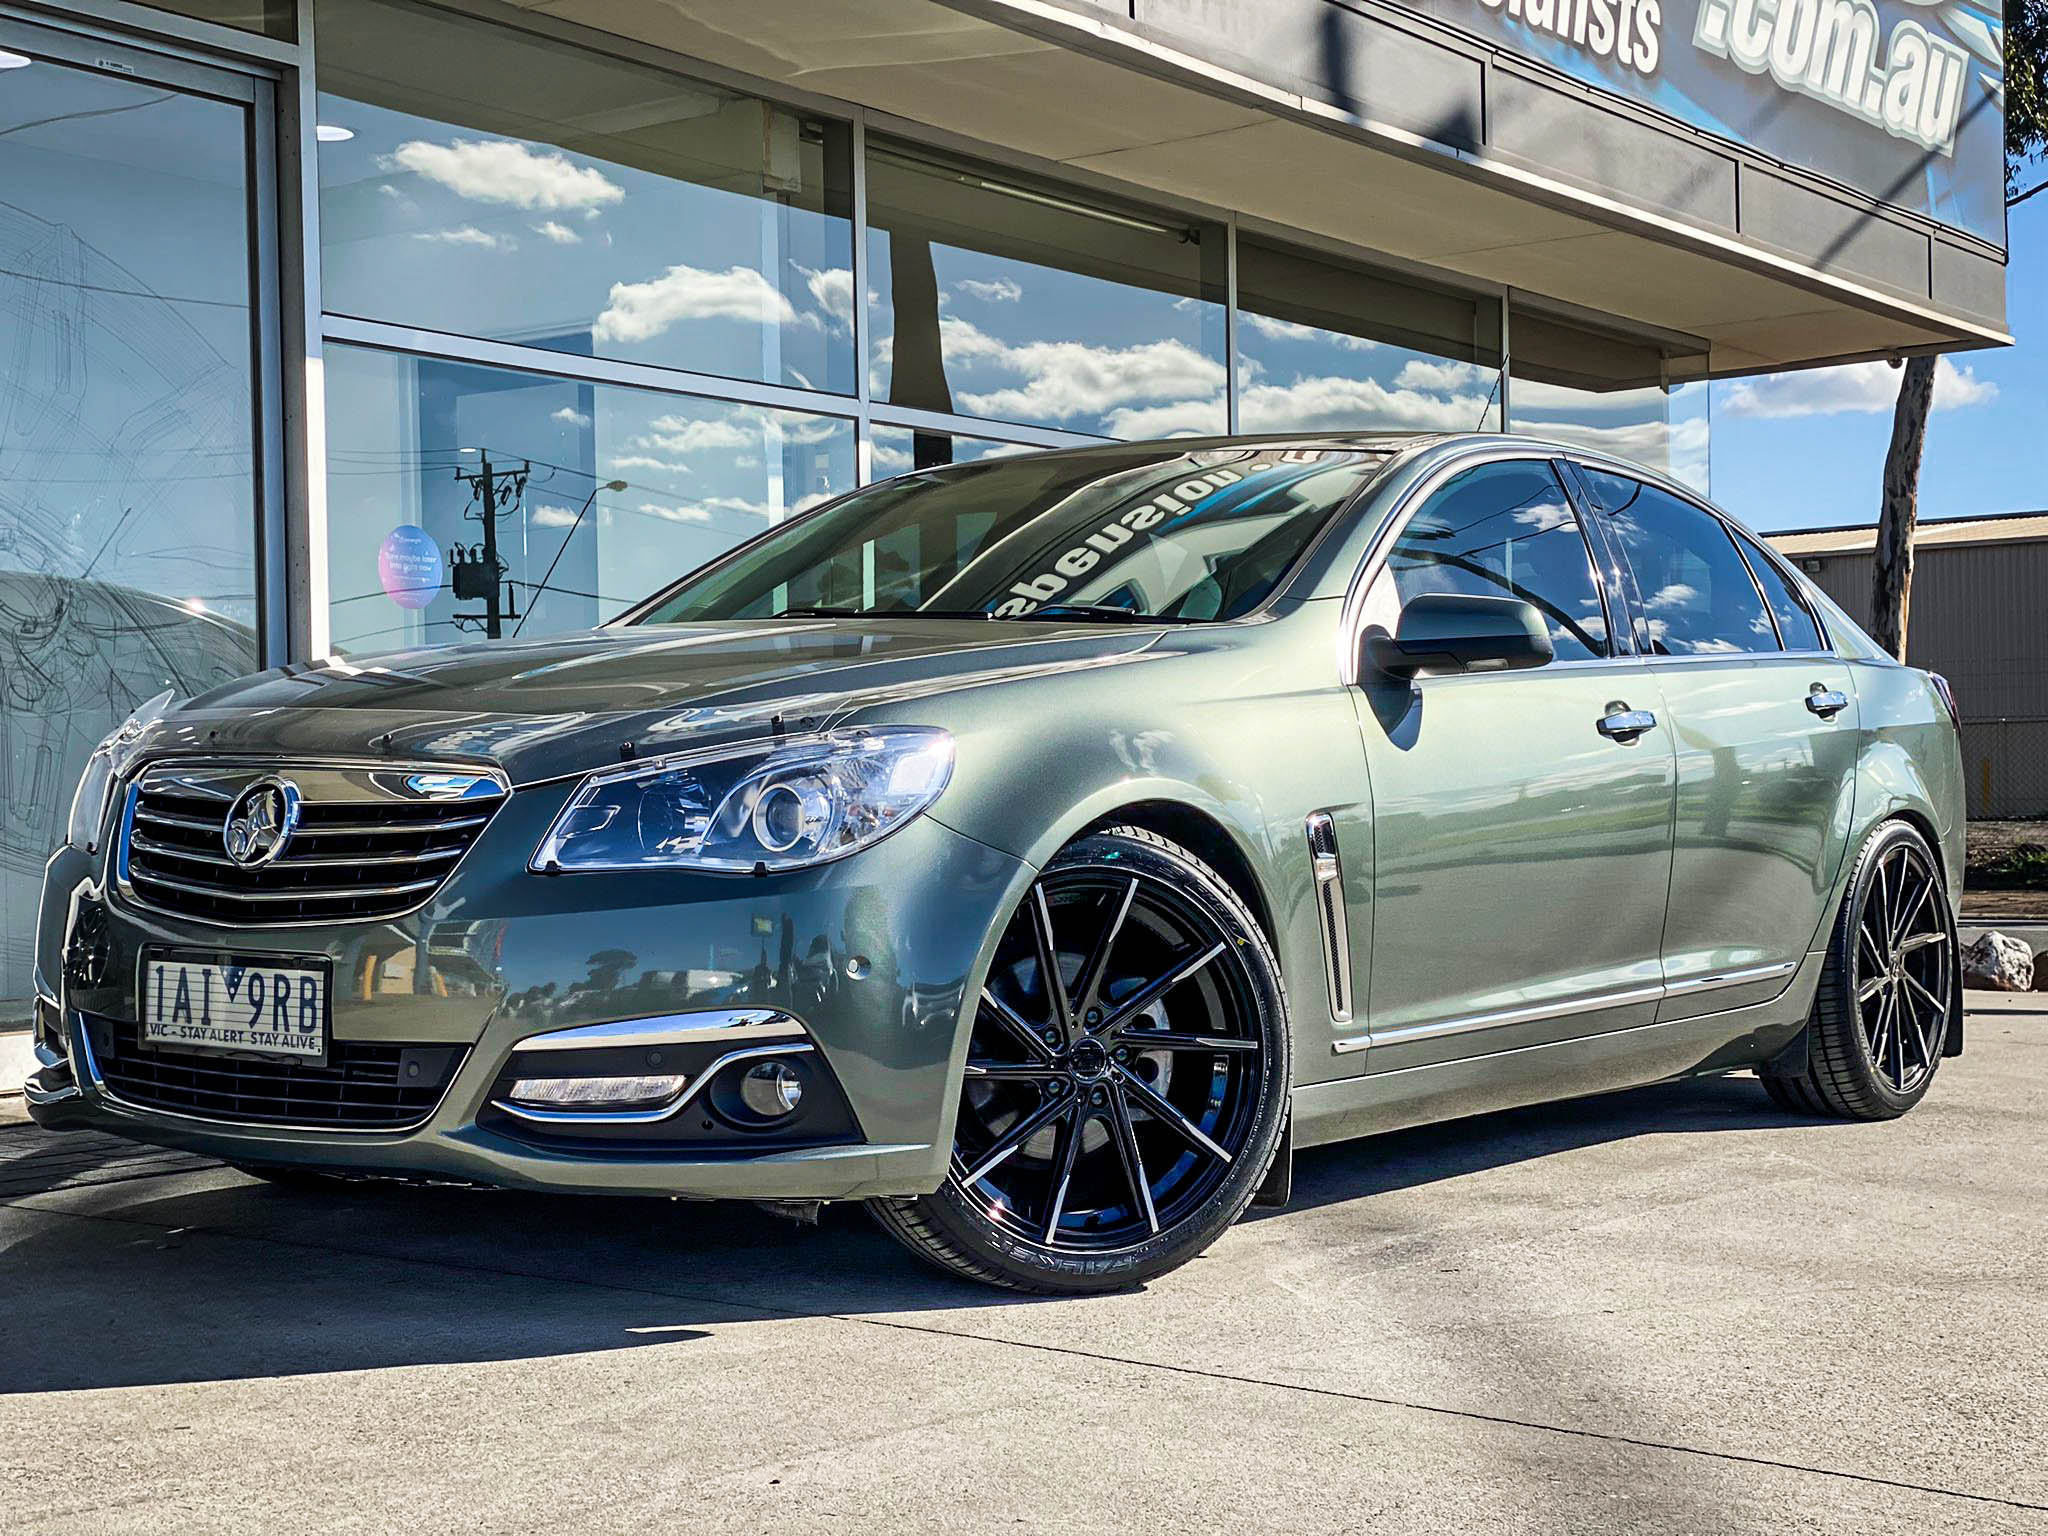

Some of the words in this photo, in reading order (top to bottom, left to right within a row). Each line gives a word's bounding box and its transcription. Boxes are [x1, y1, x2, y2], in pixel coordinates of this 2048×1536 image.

[1700, 0, 1964, 145] .com.au
[155, 965, 212, 1026] 1AI
[248, 972, 318, 1034] 9RB
[150, 1024, 168, 1037] VIC
[180, 1026, 207, 1041] STAY
[209, 1028, 244, 1044] ALERT
[250, 1032, 279, 1047] STAY
[281, 1035, 315, 1050] ALIVE
